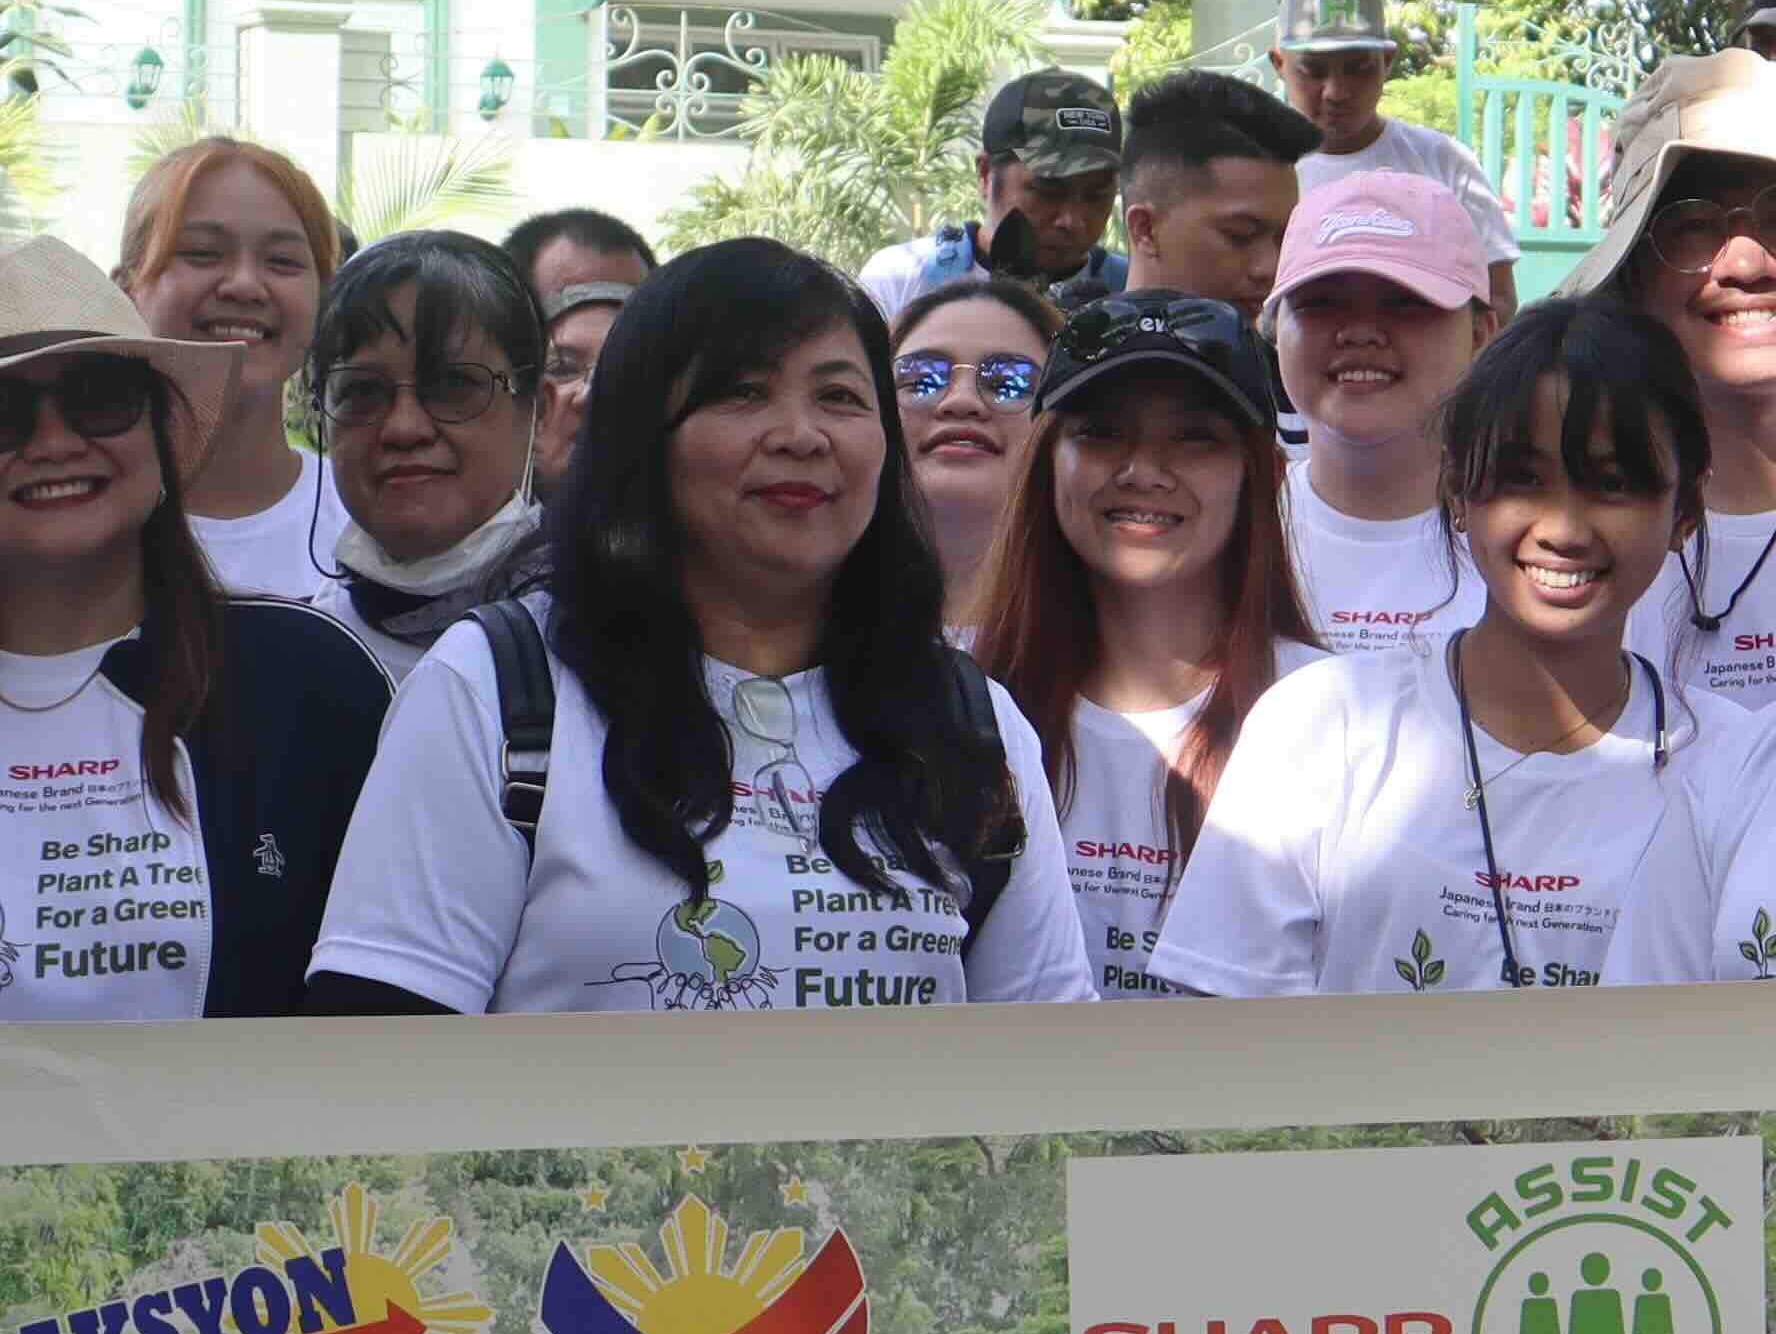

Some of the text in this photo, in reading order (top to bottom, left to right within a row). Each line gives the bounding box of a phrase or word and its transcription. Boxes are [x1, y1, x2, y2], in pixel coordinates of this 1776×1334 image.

[1704, 660, 1763, 675] Japanese
[8, 759, 120, 780] SHARP
[42, 783, 84, 799] Brand
[40, 832, 171, 861] Be Sharp
[785, 853, 832, 875] Be
[36, 869, 114, 894] Plant
[119, 866, 139, 888] A
[1475, 870, 1580, 892] SHARP
[792, 888, 883, 914] Plant
[35, 906, 86, 930] For
[91, 907, 108, 925] a
[1443, 905, 1481, 924] Caring
[1542, 917, 1603, 933] Generation
[794, 926, 850, 953] For
[857, 930, 877, 953] a
[1106, 925, 1135, 951] Be
[34, 939, 187, 980] Future
[795, 968, 937, 1008] Future
[1466, 1156, 1734, 1251] ASSIST
